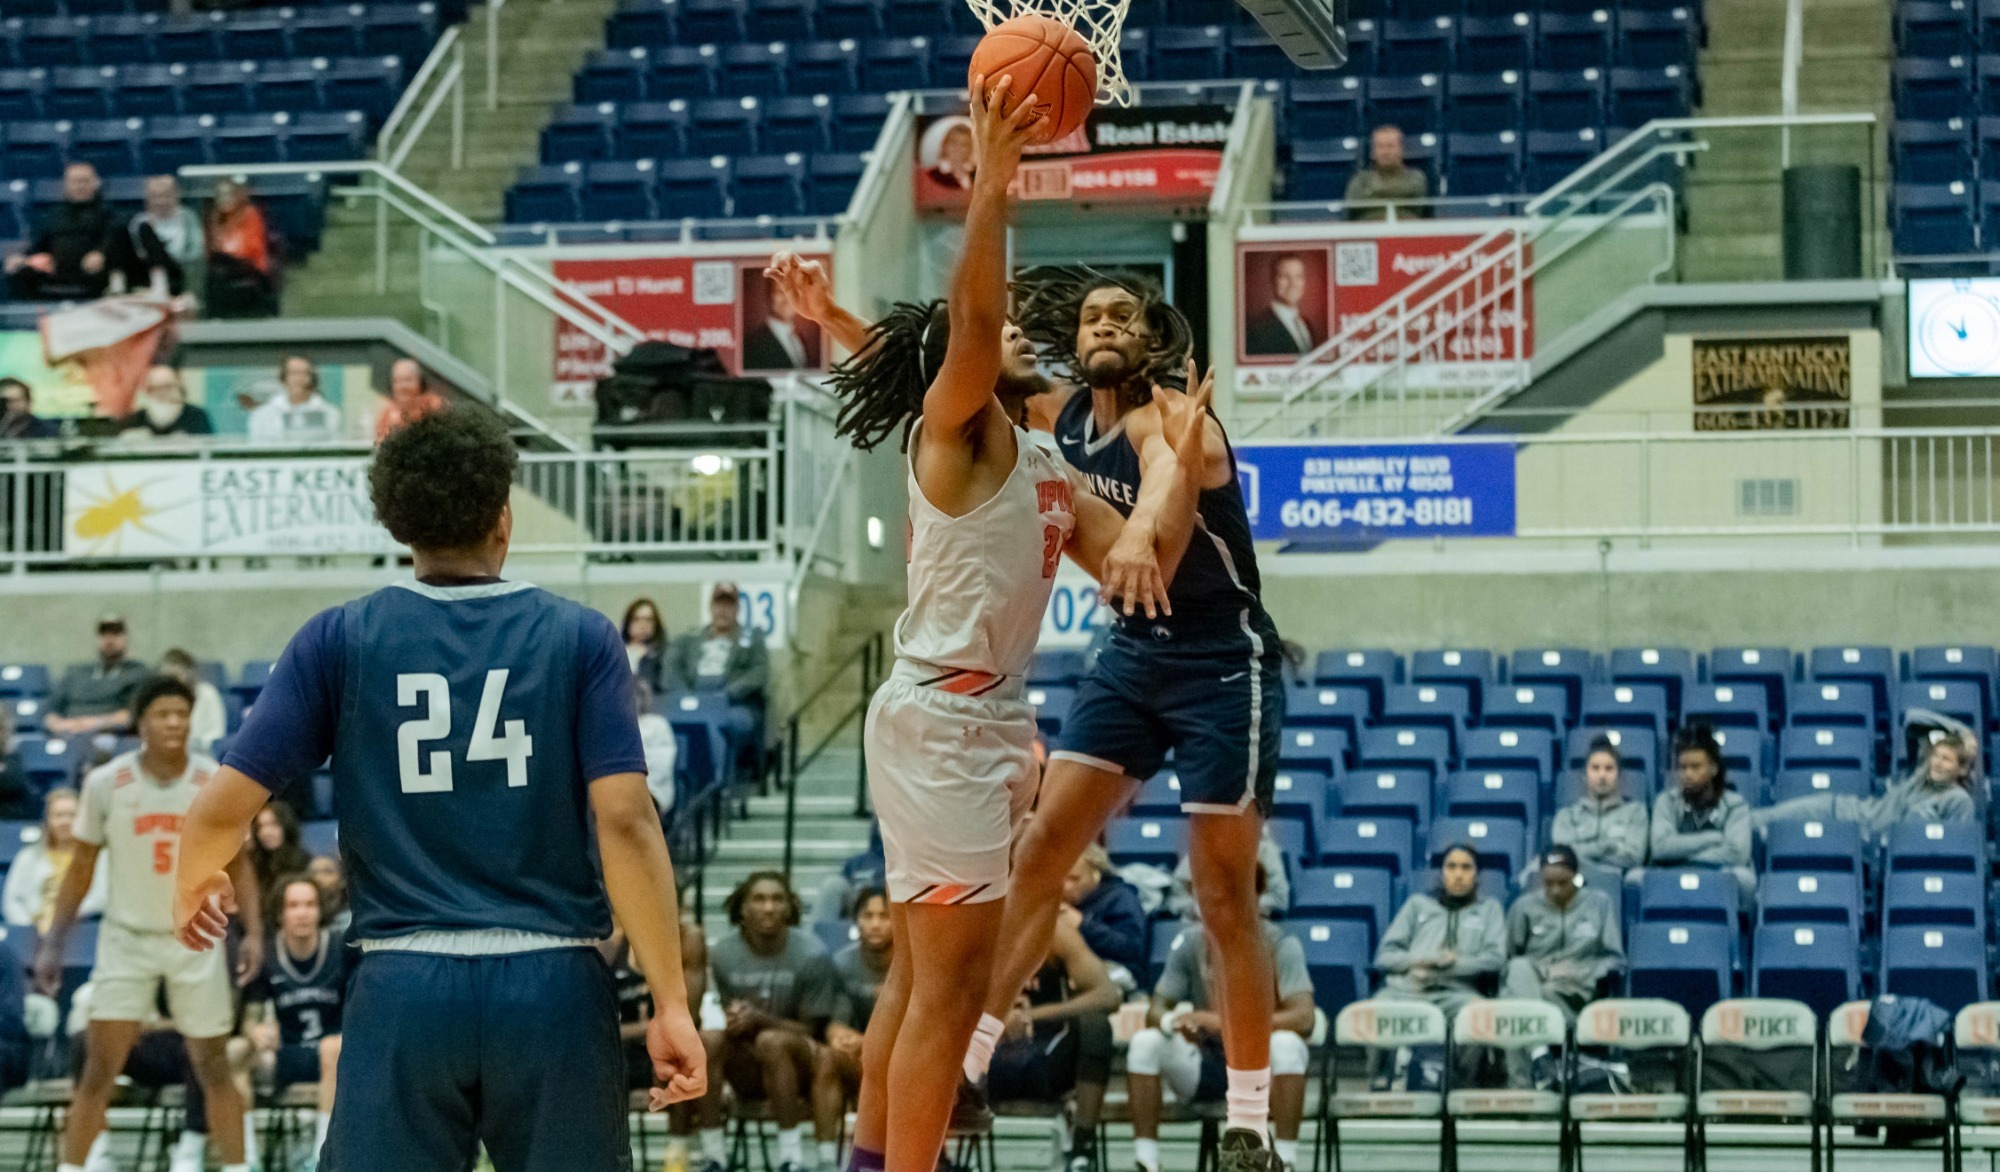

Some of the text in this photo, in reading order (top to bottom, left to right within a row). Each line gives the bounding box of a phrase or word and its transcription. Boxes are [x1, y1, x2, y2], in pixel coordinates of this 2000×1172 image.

[1096, 121, 1154, 145] Real
[1695, 344, 1850, 370] EAST KENTUCKY
[1695, 363, 1850, 401] EXTERMINATING
[1409, 456, 1451, 474] BLVD
[203, 468, 279, 492] EAST
[1383, 476, 1406, 492] KY
[1280, 497, 1473, 528] 606-432-8181
[397, 668, 533, 793] 24
[154, 840, 172, 873] 5
[299, 1008, 323, 1040] 3
